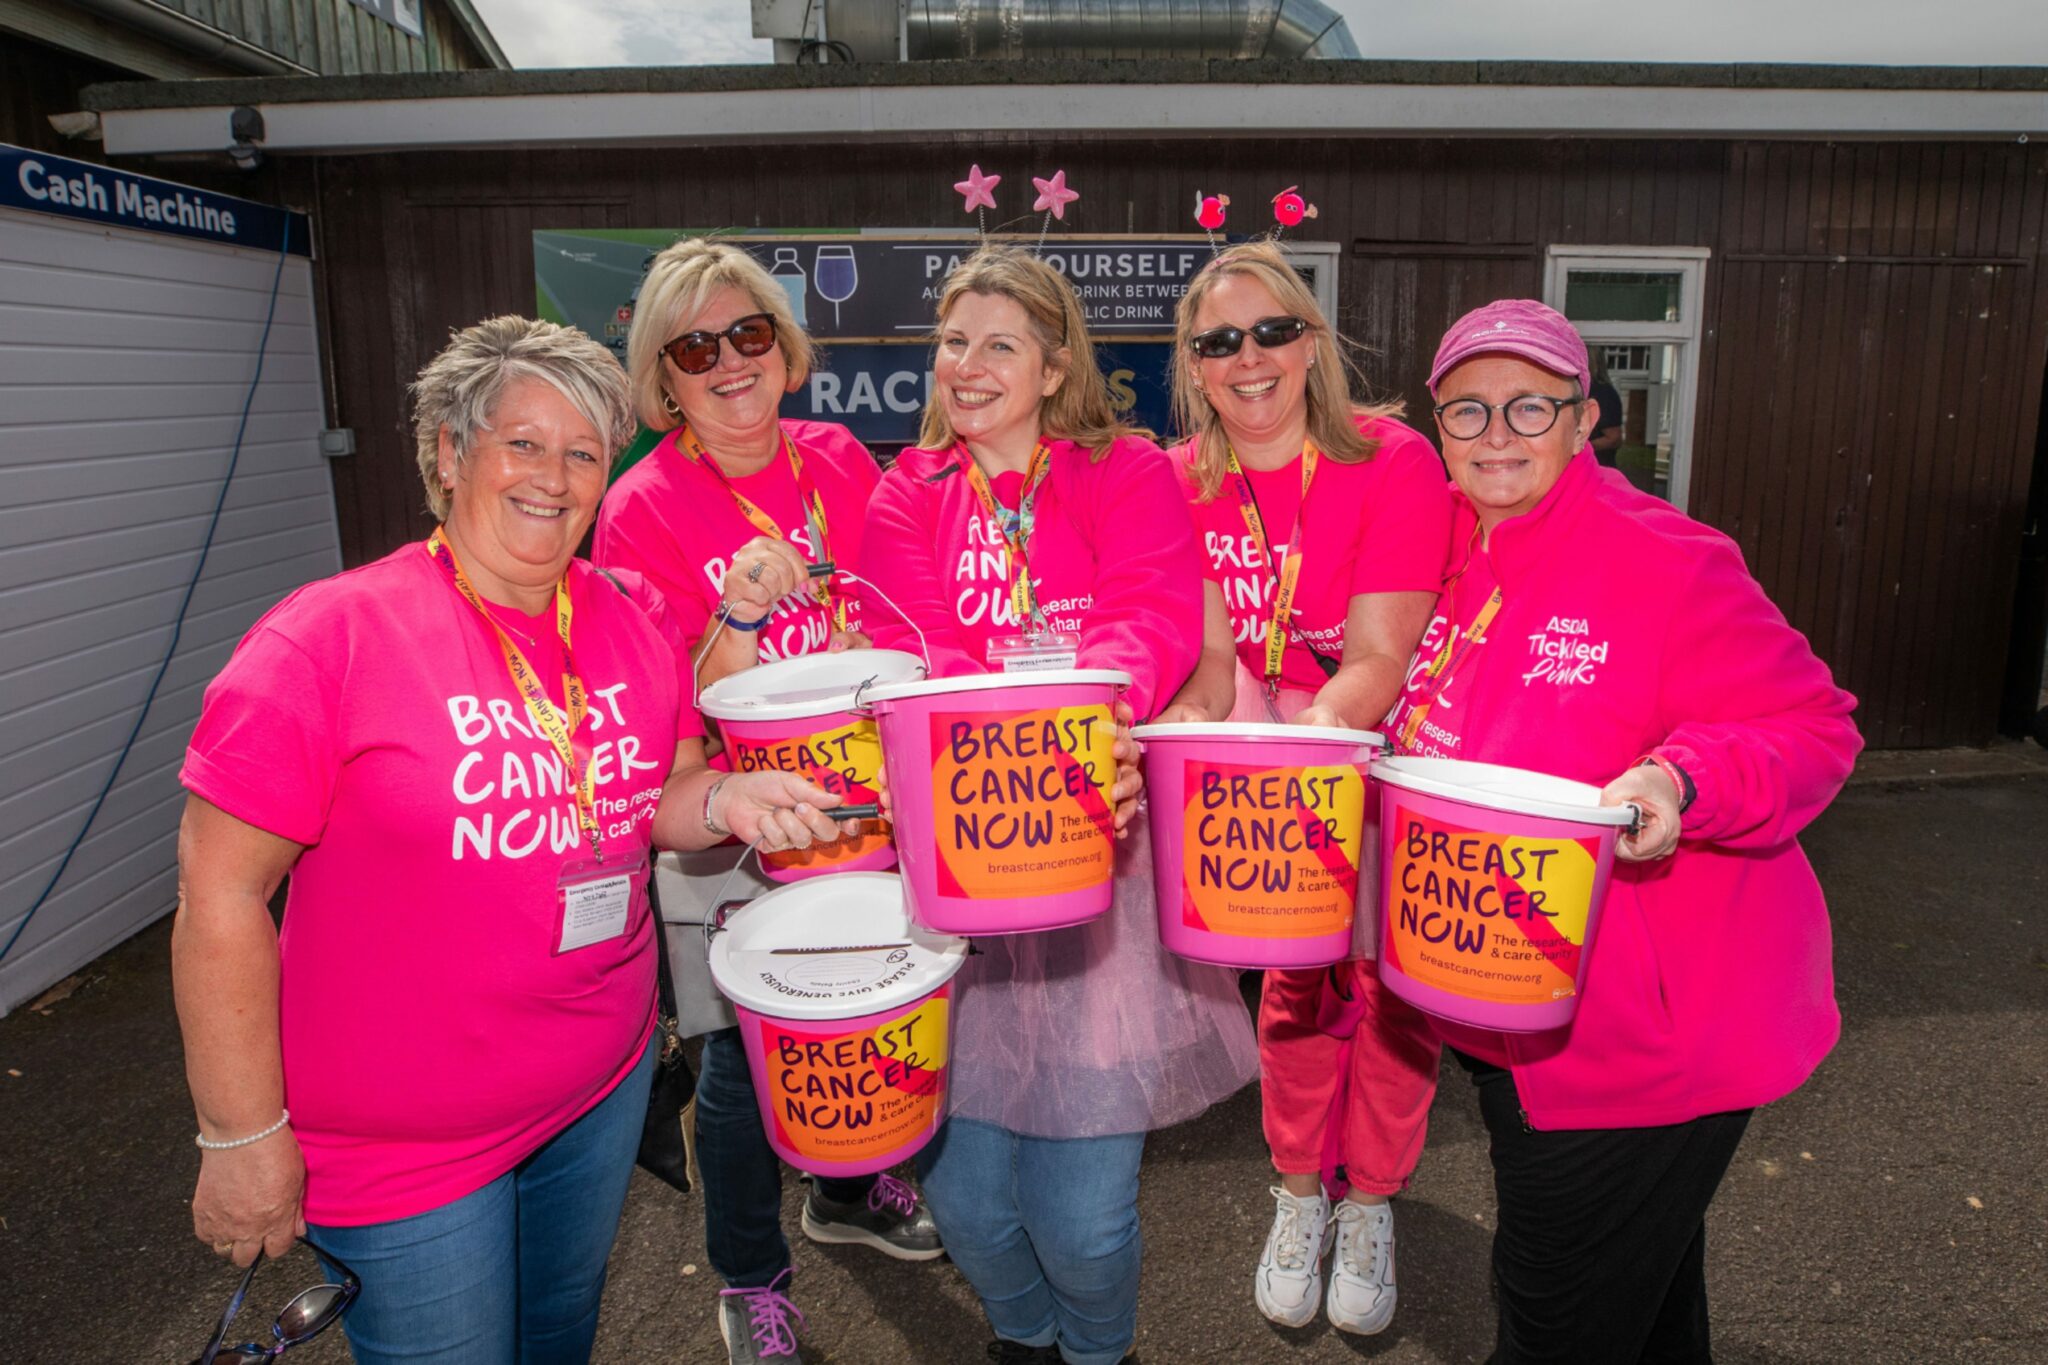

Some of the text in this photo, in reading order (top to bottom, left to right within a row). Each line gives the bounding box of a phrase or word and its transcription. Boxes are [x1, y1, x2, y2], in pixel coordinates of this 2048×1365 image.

[19, 160, 237, 235] Cash Machine
[926, 254, 1194, 278] PA OURSELF
[1072, 285, 1190, 298] DRINK BETWEE
[1115, 306, 1164, 319] DRINK
[1270, 648, 1279, 675] REAST
[1280, 588, 1290, 609] NOW
[1546, 616, 1589, 636] ASDA
[1528, 634, 1608, 664] Tickled
[569, 684, 583, 708] NOW
[447, 683, 627, 746] BREST
[736, 732, 855, 772] BREAST
[951, 715, 1098, 764] BREAST
[1420, 720, 1461, 748] resear
[630, 787, 662, 808] rese
[951, 761, 1105, 805] CANCER
[1202, 771, 1344, 810] BREAST
[452, 802, 580, 860] NOW
[955, 809, 1053, 850] NOW
[1060, 815, 1081, 827] The
[1060, 831, 1068, 843] &
[1071, 829, 1093, 842] care
[1198, 814, 1346, 853] CANCER
[988, 851, 1102, 873] breastcancernow.org
[1407, 821, 1559, 882] BREAST
[1200, 853, 1291, 893] NOW
[1298, 867, 1319, 878] The
[1297, 881, 1305, 892] &
[1308, 882, 1330, 892] care
[1228, 902, 1338, 916] breastcancernow.org
[1402, 862, 1559, 921] CANCER
[1400, 898, 1571, 954] NOW The research
[1420, 951, 1542, 984] breastcancernow.org
[1491, 948, 1499, 959] &
[1503, 951, 1532, 961] care
[760, 962, 915, 998] PLEASE GIVE GENEROUSLY
[778, 1015, 922, 1067] BREAST
[781, 1051, 930, 1099] CANCER
[785, 1097, 873, 1129] NOW
[880, 1098, 901, 1111] The
[815, 1110, 926, 1146] breastcancernow.org
[880, 1113, 888, 1122] &
[890, 1101, 914, 1118] care
